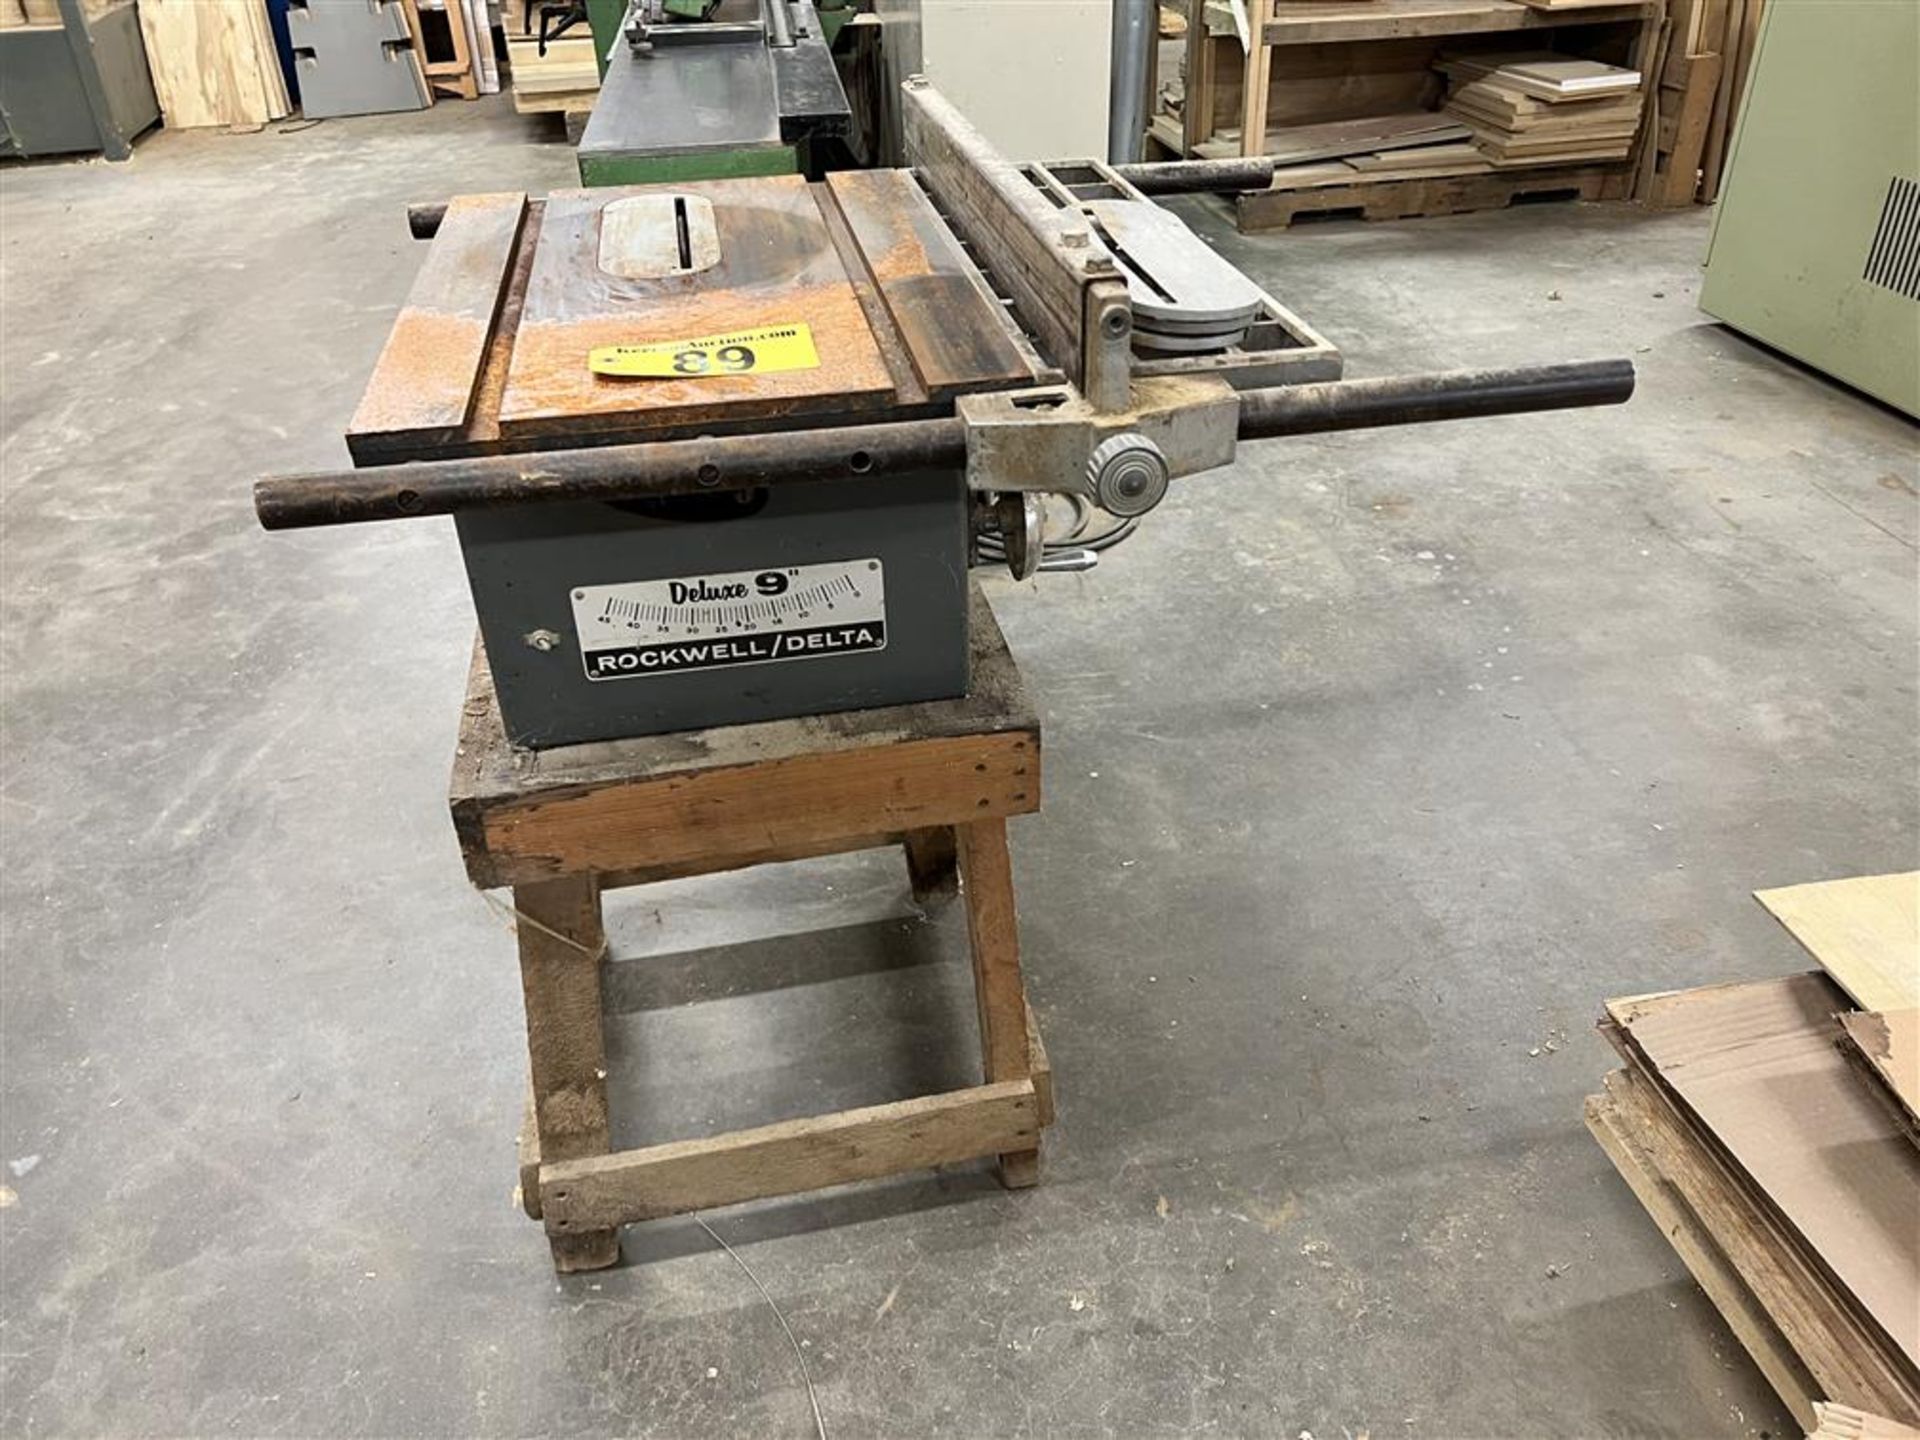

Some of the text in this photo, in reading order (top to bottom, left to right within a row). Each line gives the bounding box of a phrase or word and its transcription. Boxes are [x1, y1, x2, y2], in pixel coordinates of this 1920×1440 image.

[672, 345, 757, 374] 89
[668, 579, 749, 605] Deluxe
[597, 616, 611, 624] 45
[626, 621, 641, 629] 40
[597, 628, 874, 672] ROCKWELL/DELTA
